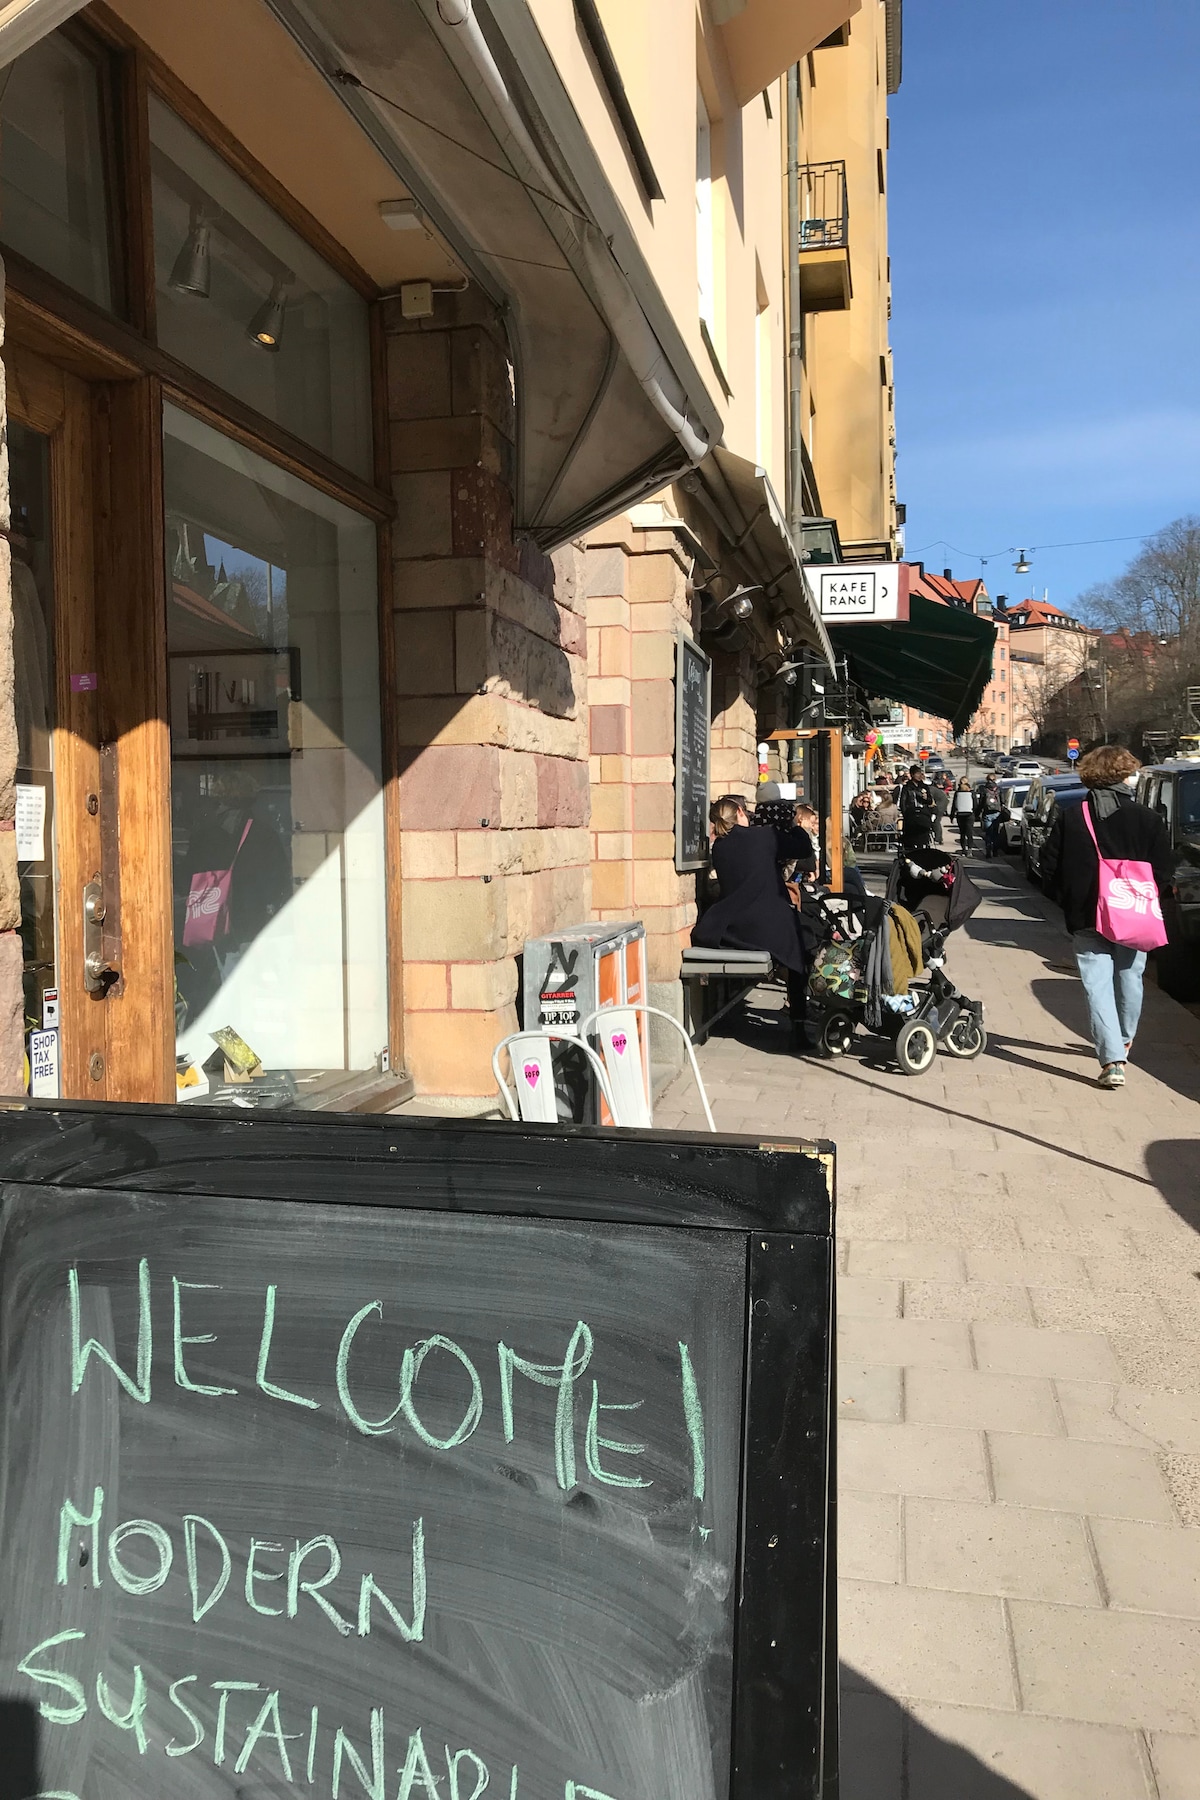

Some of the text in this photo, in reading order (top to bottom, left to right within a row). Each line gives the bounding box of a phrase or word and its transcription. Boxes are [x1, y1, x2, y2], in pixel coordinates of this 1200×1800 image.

[829, 582, 867, 593] KAFE
[829, 595, 867, 606] RANG
[544, 1011, 575, 1021] TIP TOP
[33, 1034, 56, 1050] SHOP
[33, 1050, 50, 1064] TAX
[34, 1063, 54, 1079] FREE
[56, 1485, 426, 1643] MODERN
